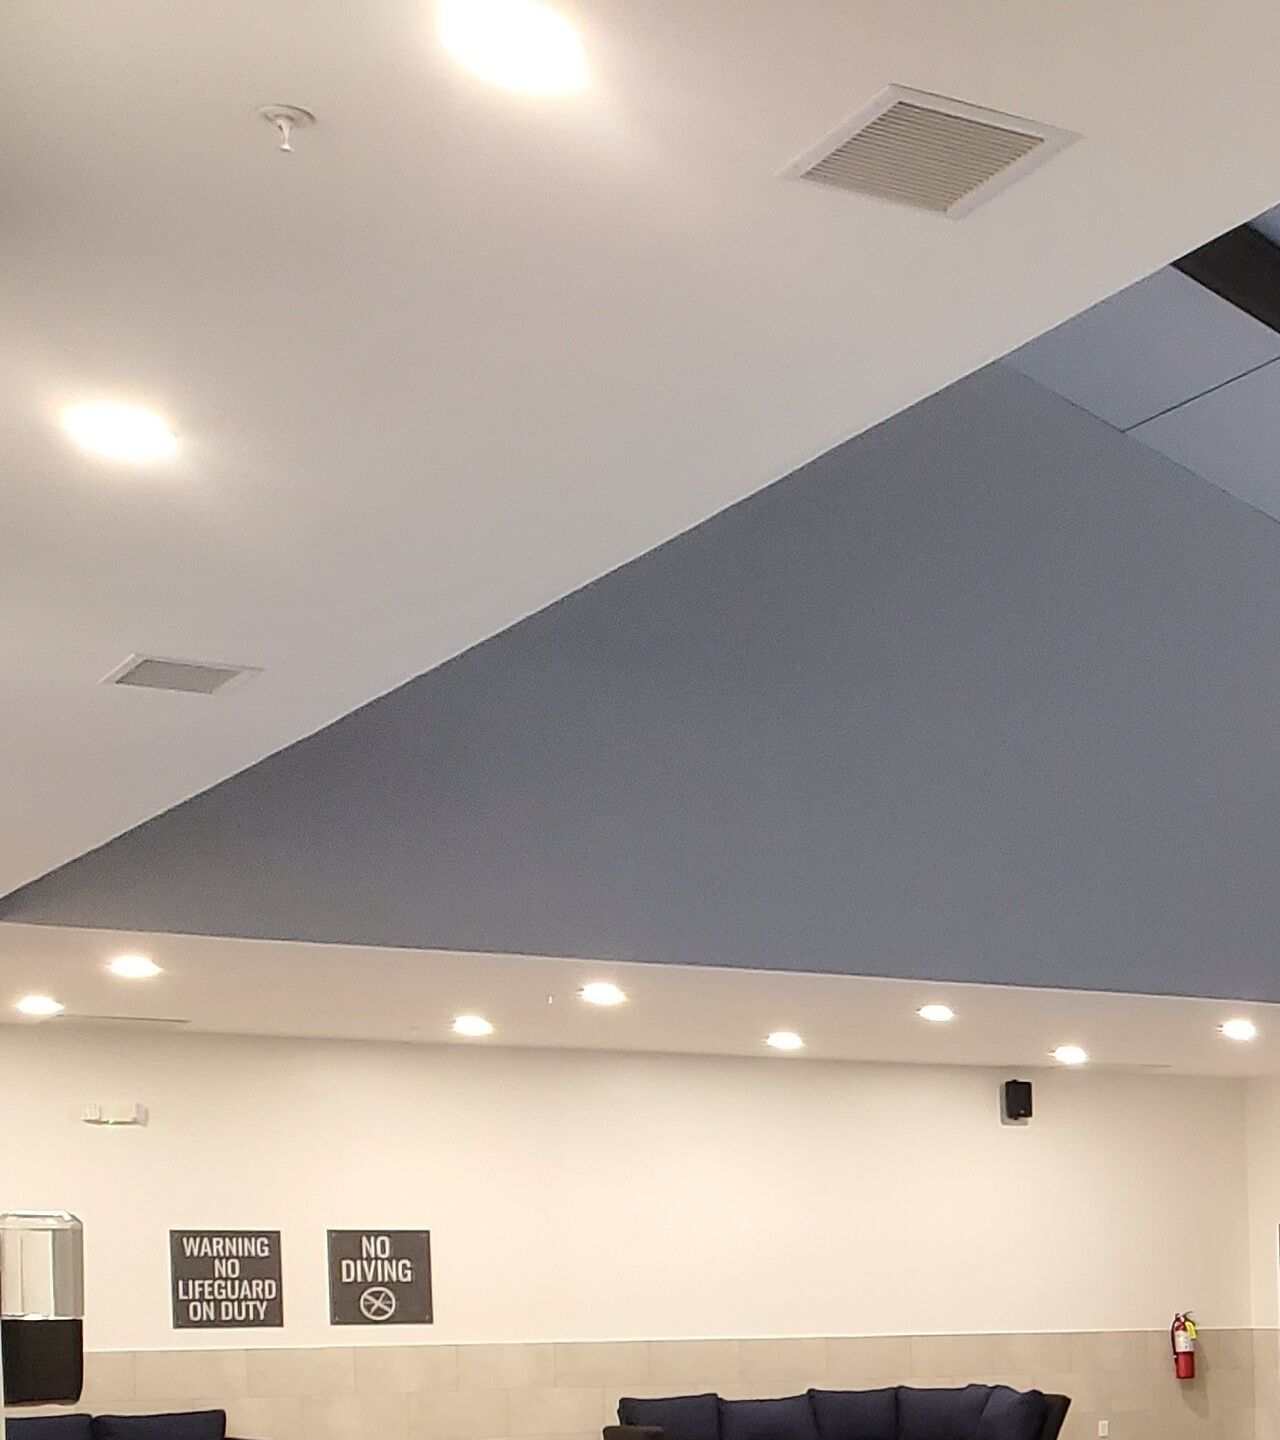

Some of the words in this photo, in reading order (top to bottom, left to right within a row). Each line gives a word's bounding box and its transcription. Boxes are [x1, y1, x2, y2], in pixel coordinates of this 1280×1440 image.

[182, 1236, 270, 1258] WARNING
[362, 1235, 390, 1259] NO
[214, 1258, 240, 1279] NO
[341, 1259, 412, 1283] DIVING
[178, 1279, 277, 1301] LIFEGUARD
[188, 1301, 215, 1321] ON
[221, 1300, 267, 1321] DUTY
